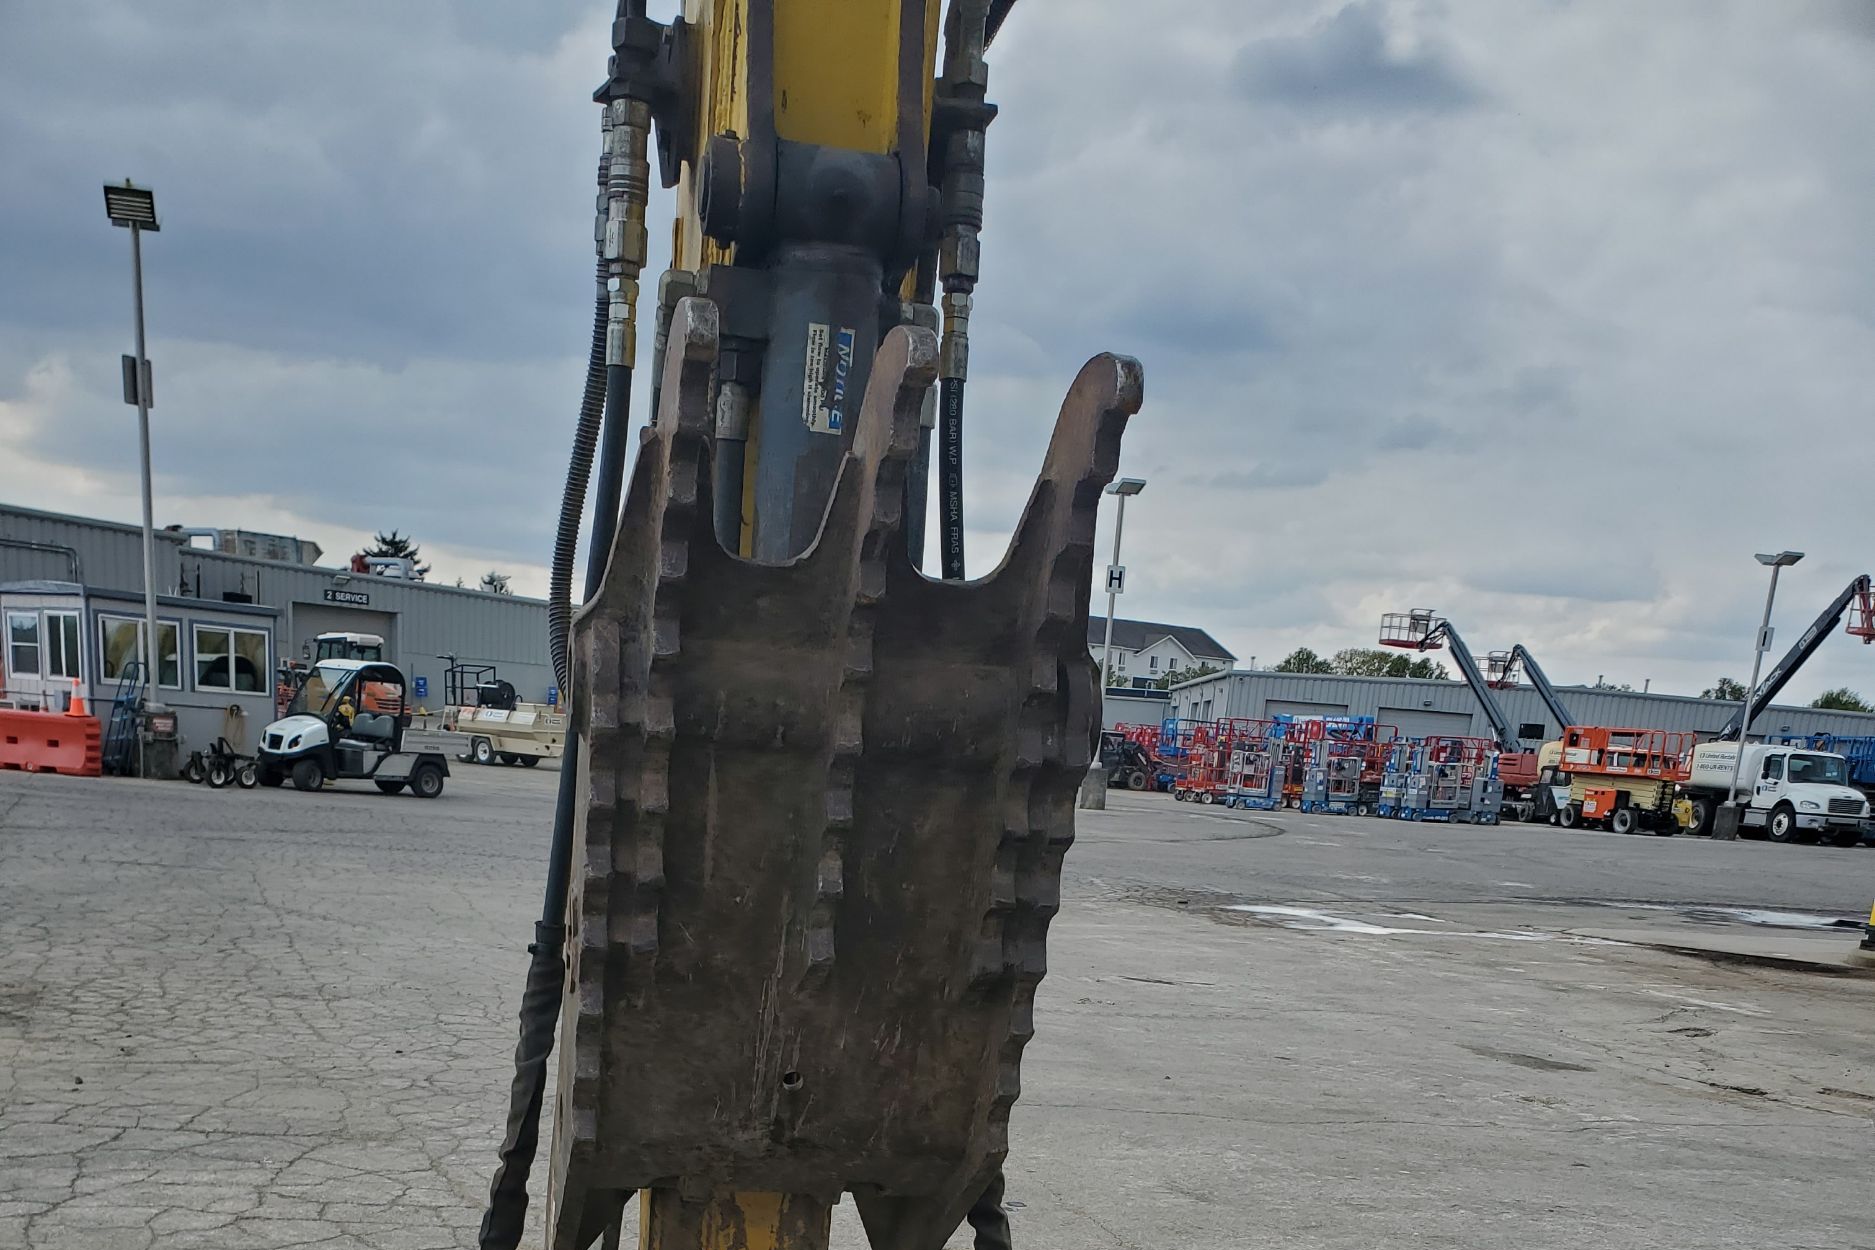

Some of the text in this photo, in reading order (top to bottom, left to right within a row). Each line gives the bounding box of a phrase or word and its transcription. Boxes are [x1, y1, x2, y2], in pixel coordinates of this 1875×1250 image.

[949, 491, 960, 554] MSHA FRAS
[1109, 570, 1122, 588] H
[326, 590, 367, 603] 2 SERVICE
